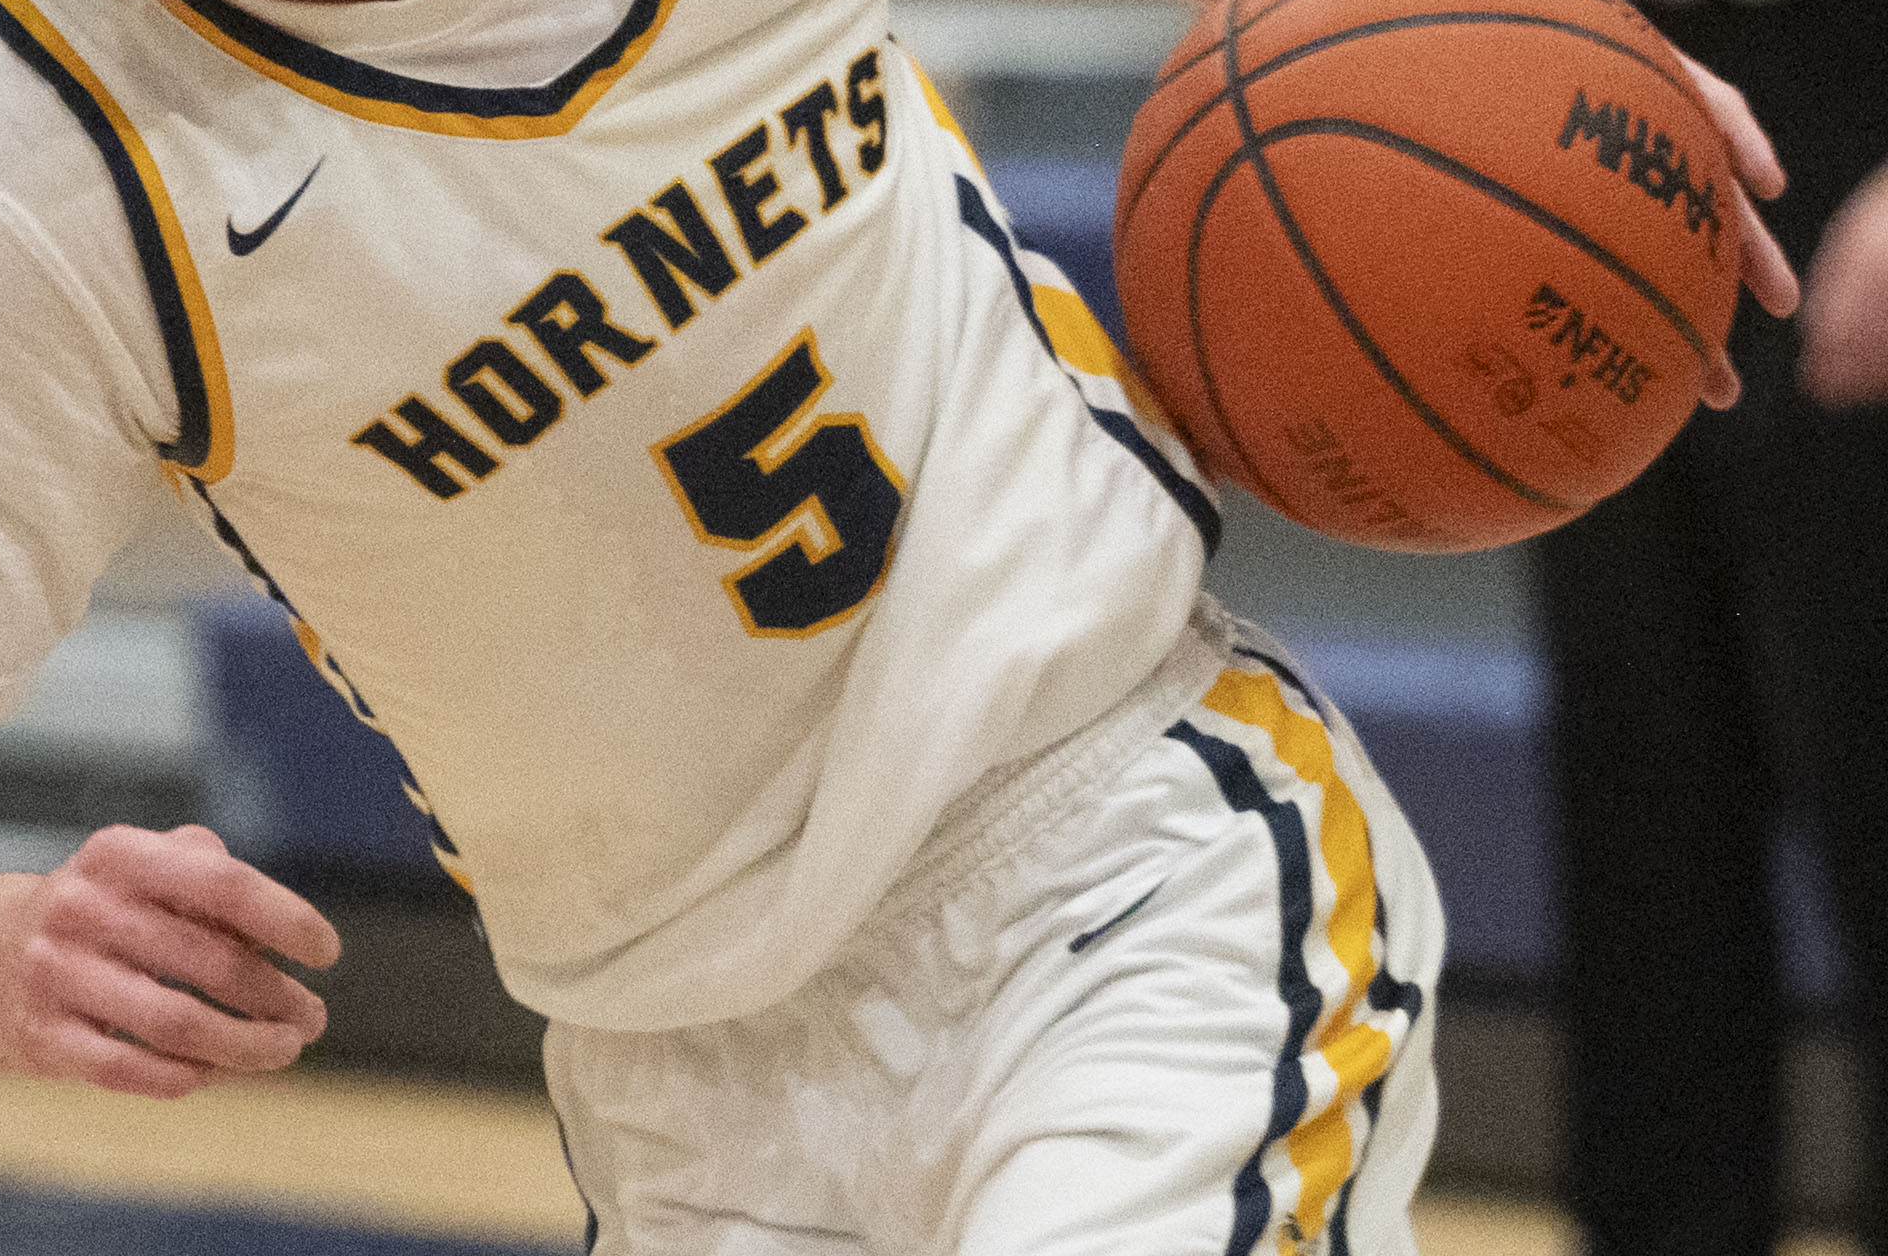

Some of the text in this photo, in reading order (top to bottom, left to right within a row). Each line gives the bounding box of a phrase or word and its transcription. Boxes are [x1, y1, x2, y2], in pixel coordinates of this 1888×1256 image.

[348, 47, 888, 502] HORNETS
[1548, 307, 1657, 405] NFHS
[648, 325, 909, 640] 5
